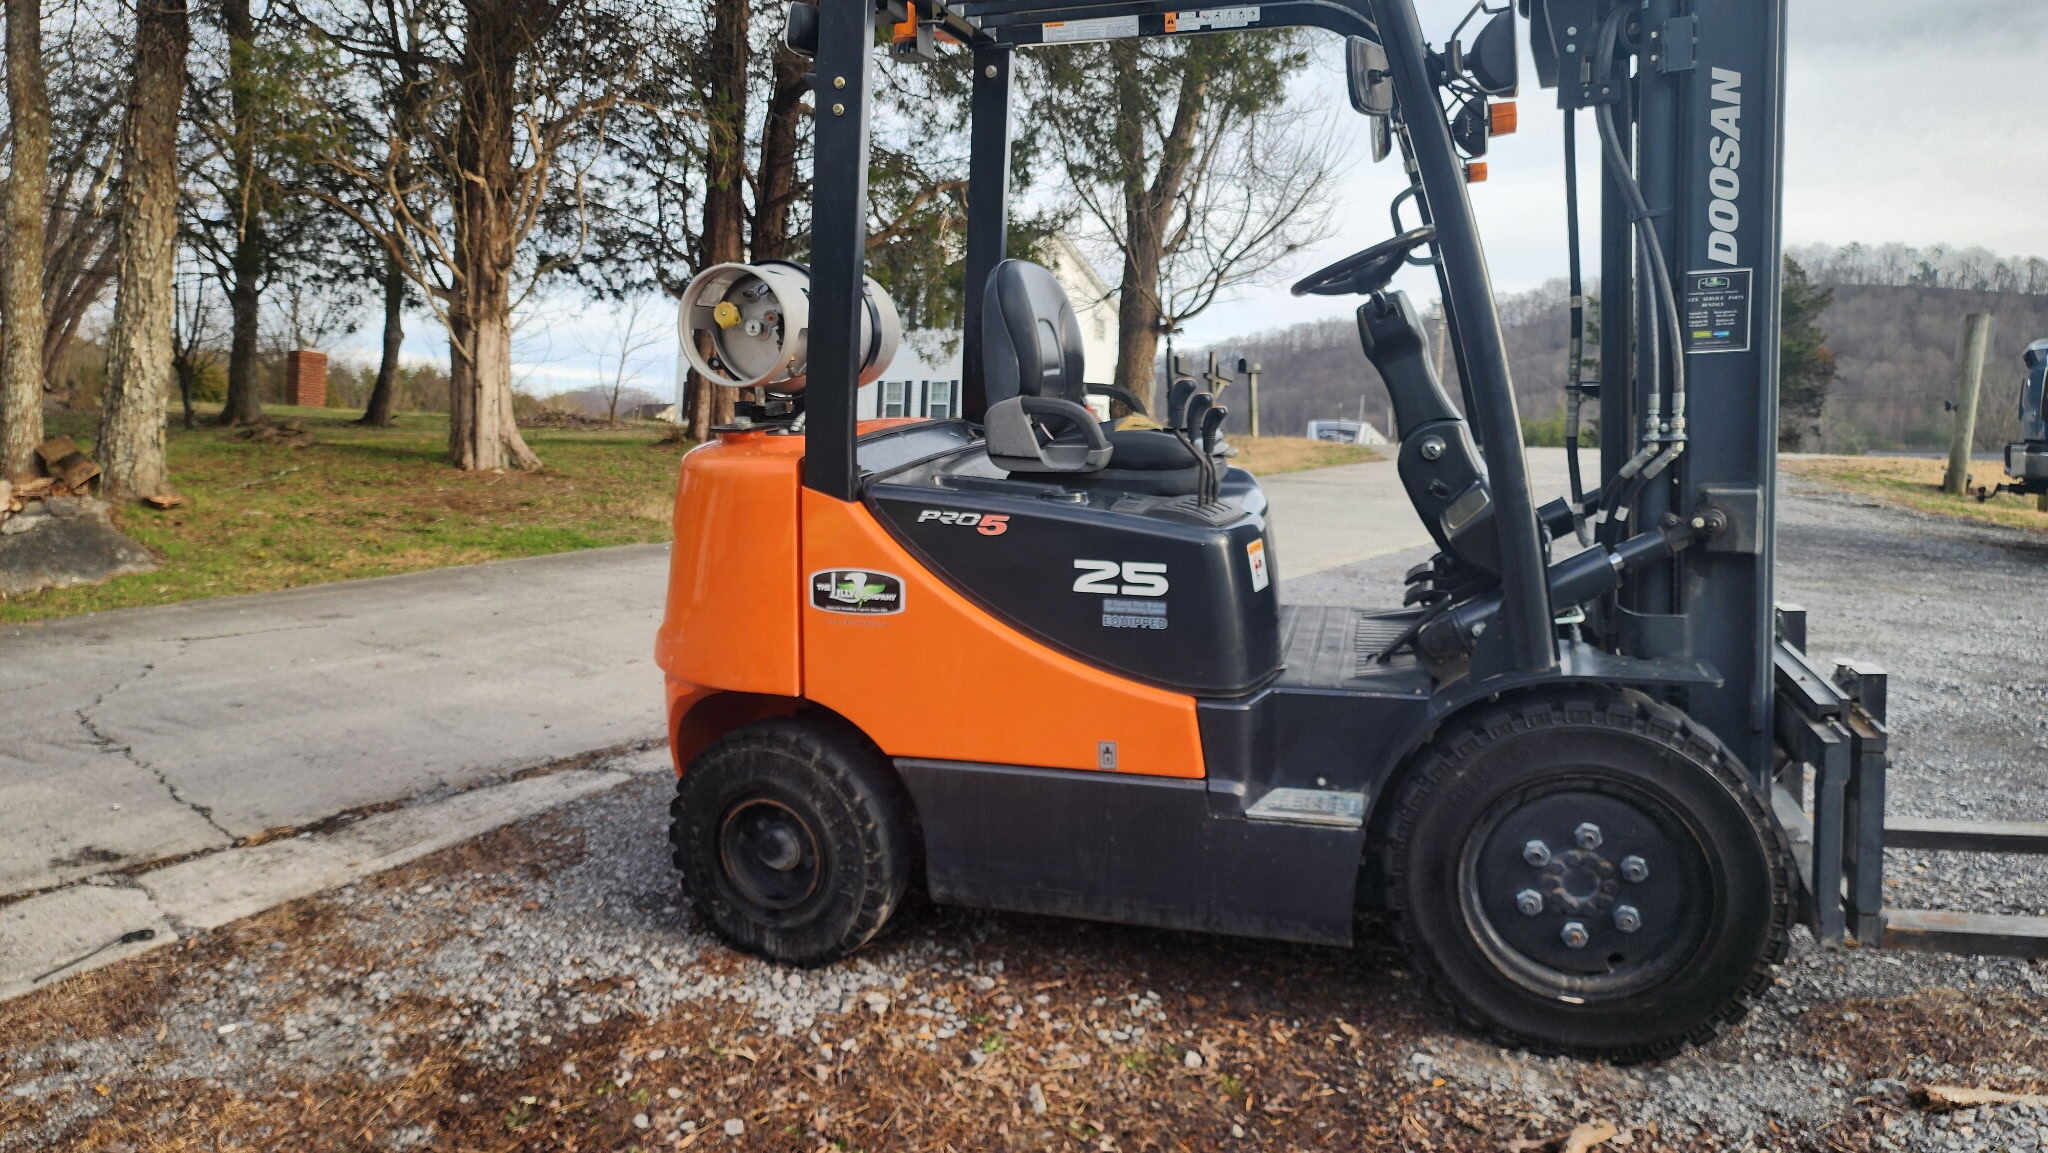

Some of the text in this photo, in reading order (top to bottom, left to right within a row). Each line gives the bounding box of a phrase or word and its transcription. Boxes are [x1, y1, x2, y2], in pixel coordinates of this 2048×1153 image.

[1707, 66, 1742, 266] DOOSAN
[816, 583, 831, 592] THE
[1073, 559, 1169, 597] 25
[1102, 614, 1168, 630] EQUIPPED
